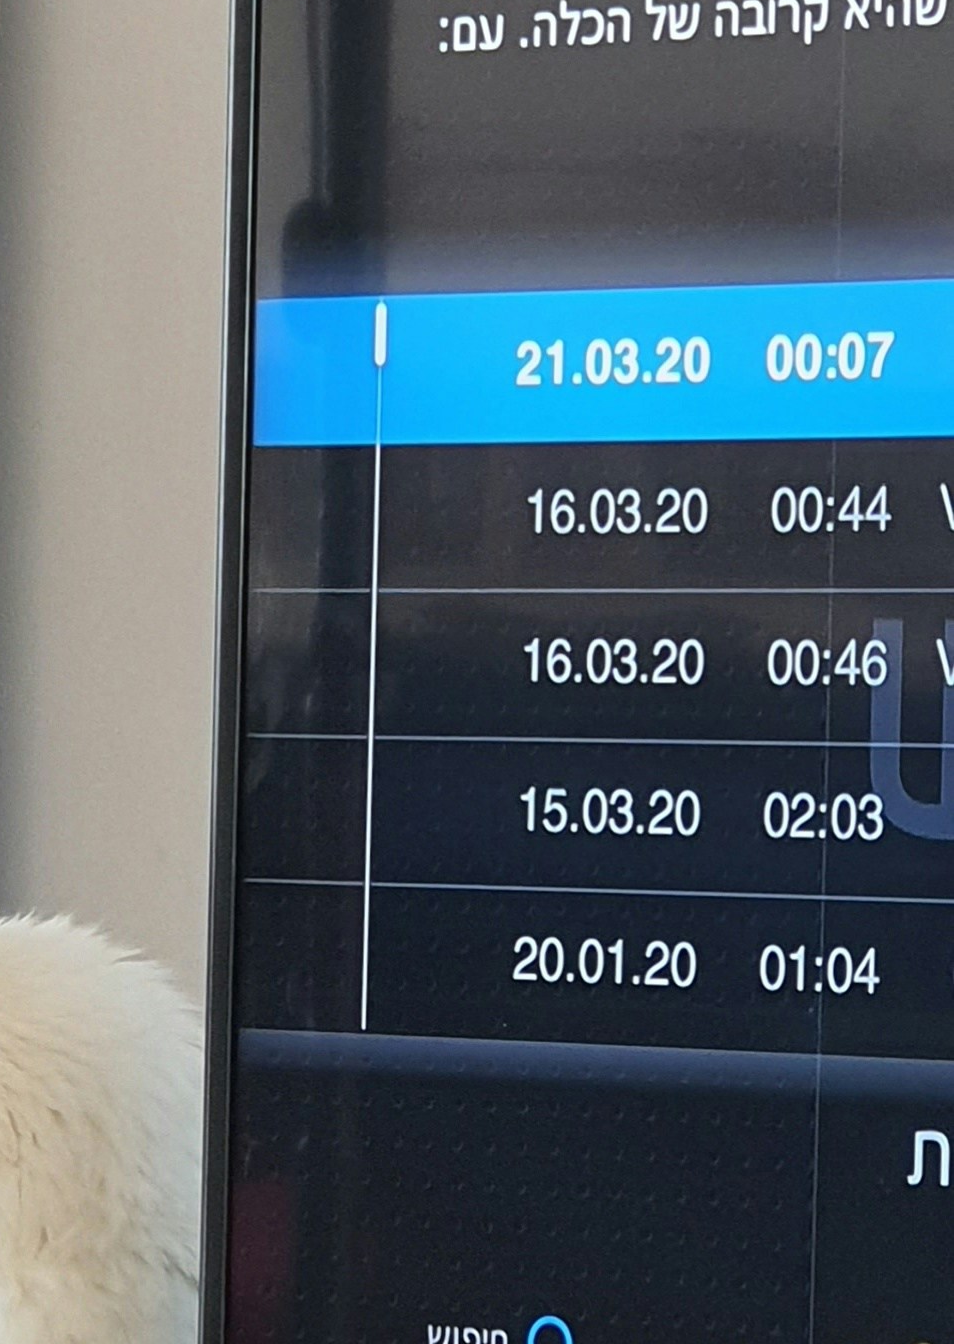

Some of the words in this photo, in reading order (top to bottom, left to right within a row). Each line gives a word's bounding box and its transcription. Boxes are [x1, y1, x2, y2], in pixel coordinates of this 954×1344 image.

[439, 11, 504, 54] עם:
[519, 2, 631, 49] הכלה.
[515, 336, 712, 387] 21.03.20
[765, 332, 895, 381] 00:07
[526, 485, 709, 535] 16.03.20
[770, 484, 892, 533] 00:44
[523, 637, 705, 686] 16.03.20
[767, 638, 888, 687] 00:46
[519, 786, 701, 837] 15.03.20
[763, 791, 885, 841] 02:03
[512, 937, 698, 988] 20.01.20
[759, 944, 880, 995] 01:04
